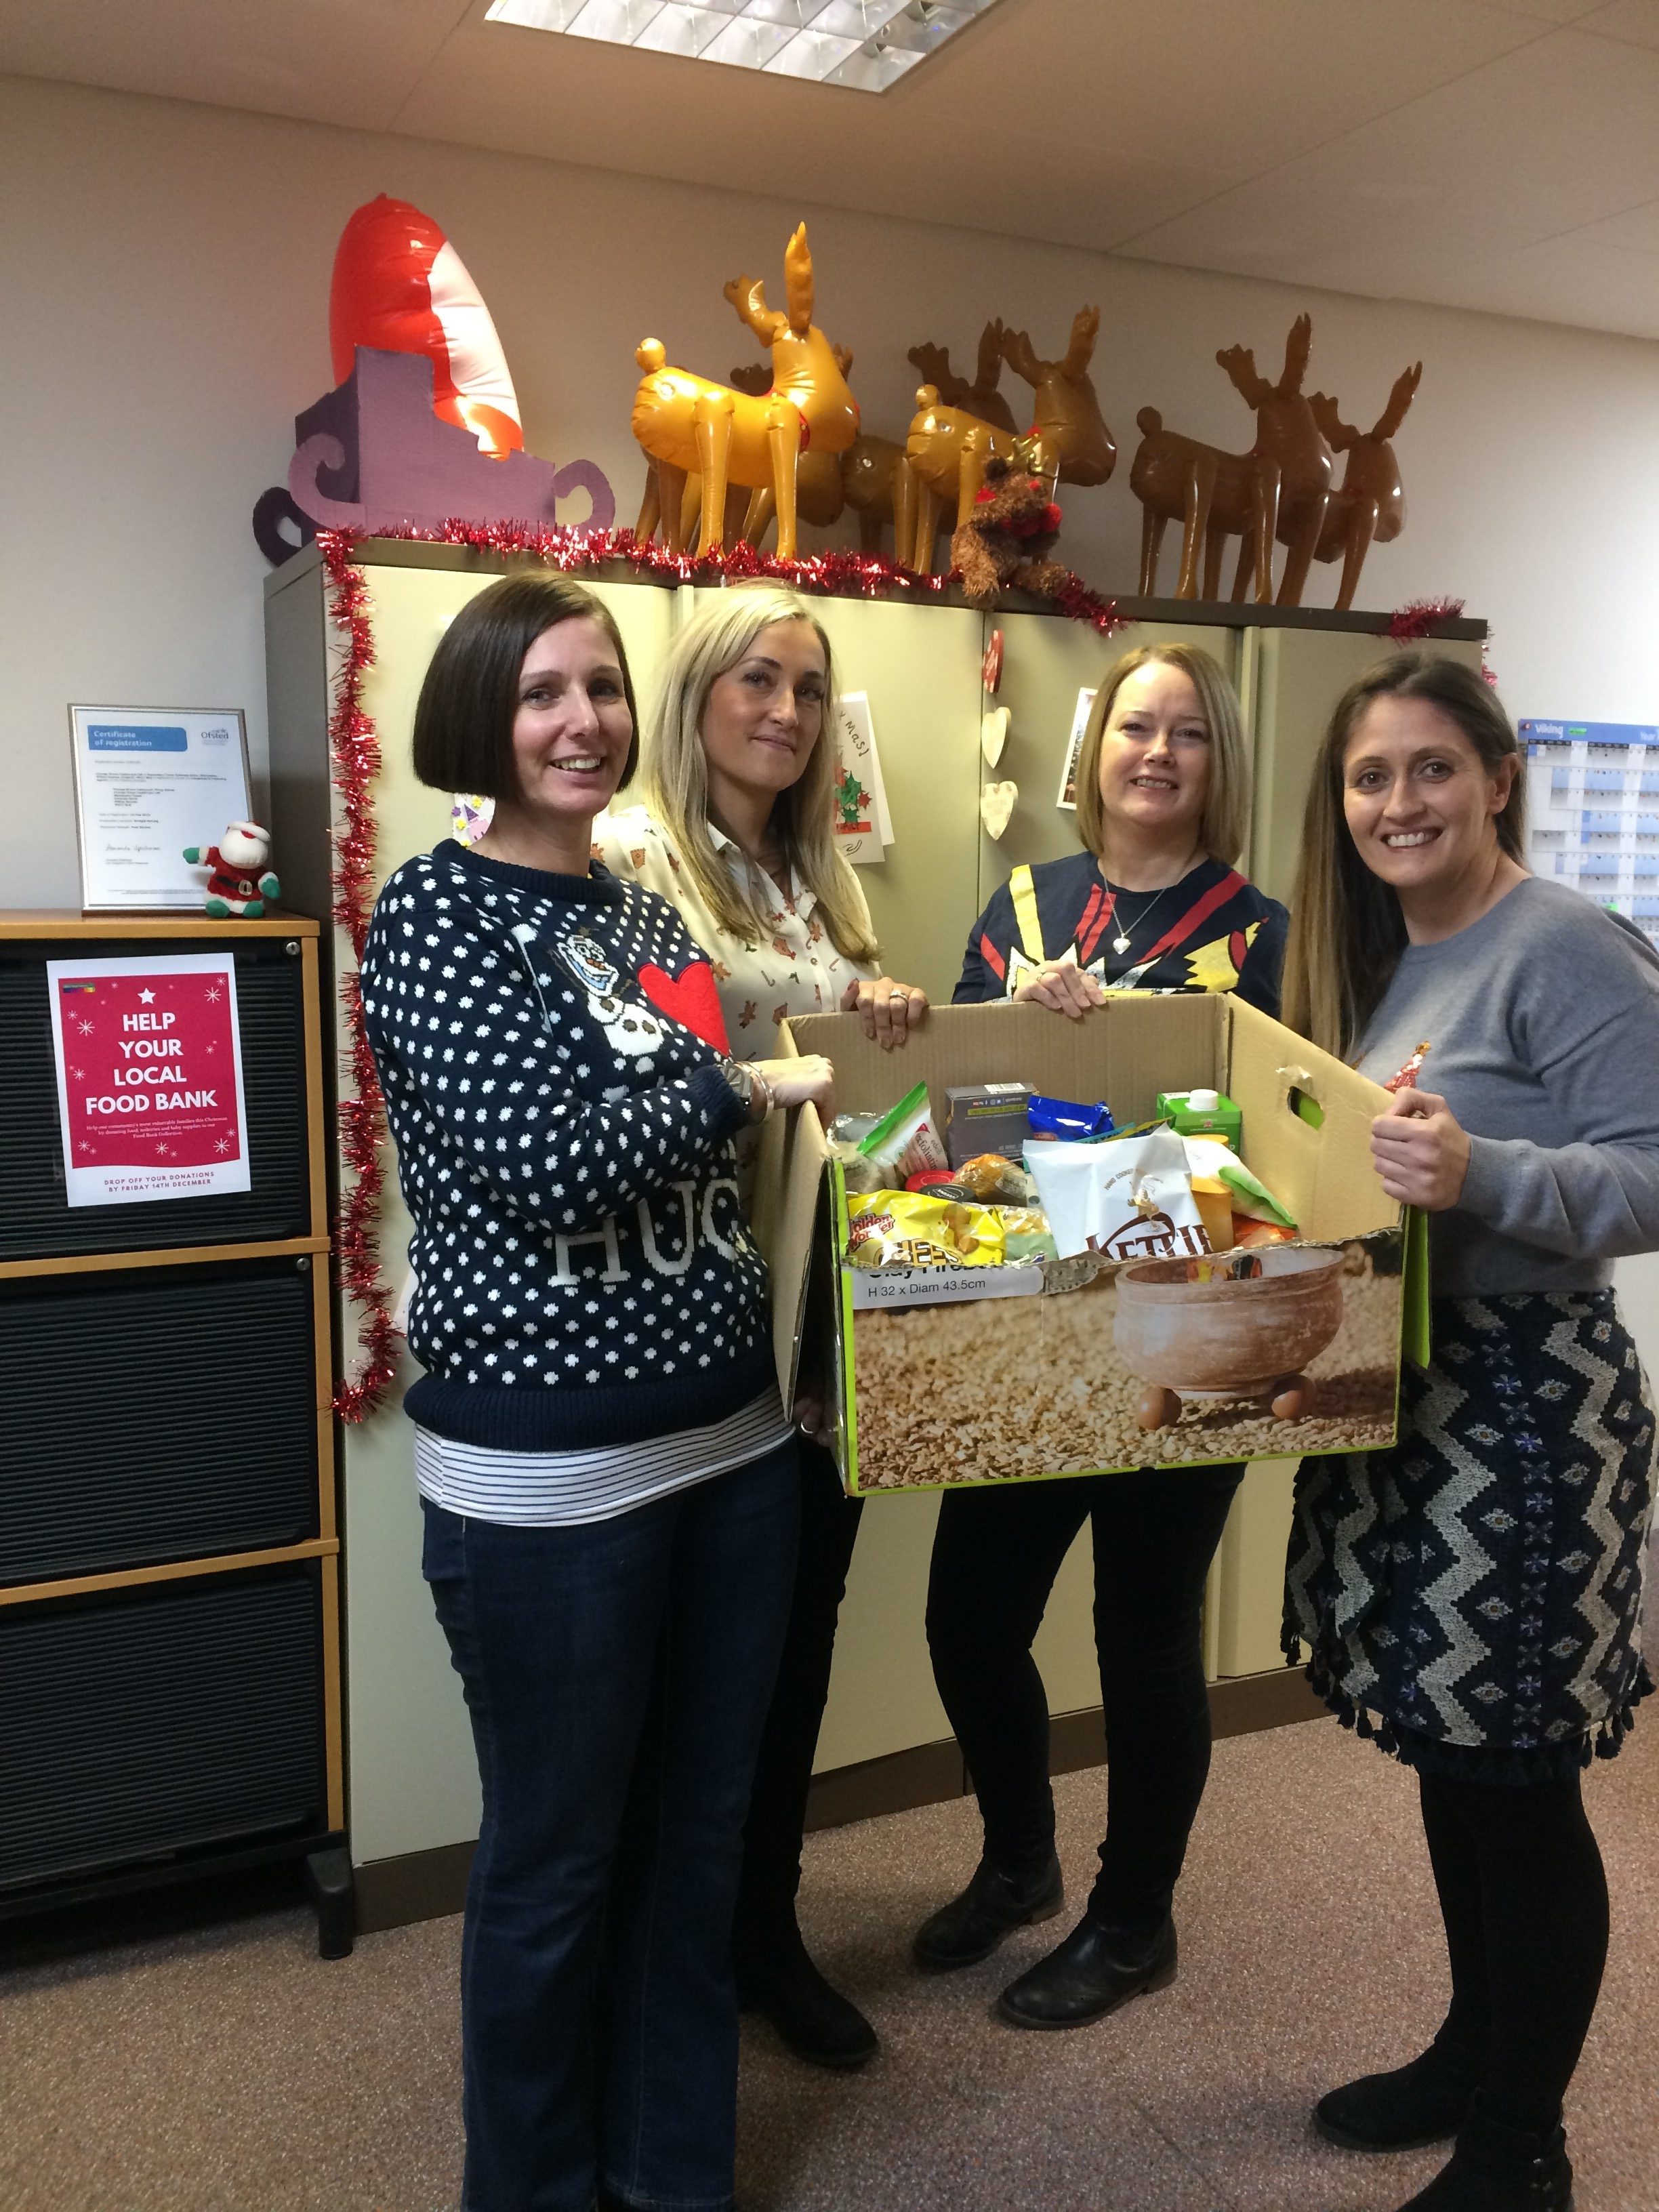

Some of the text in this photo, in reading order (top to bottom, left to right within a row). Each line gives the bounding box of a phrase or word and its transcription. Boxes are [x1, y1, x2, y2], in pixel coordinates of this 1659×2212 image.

[201, 731, 228, 739] Ofsted
[123, 1012, 176, 1031] HELP
[118, 1039, 184, 1059] YOUR
[114, 1065, 186, 1086] LOCAL
[86, 1090, 218, 1115] FOOD BANK
[169, 1171, 214, 1181] DONATIONS
[173, 1179, 211, 1187] DECEMBER
[1104, 1178, 1116, 1191] HAND
[868, 1288, 877, 1297] H
[881, 1286, 895, 1296] 32
[909, 1283, 939, 1294] Diam
[943, 1279, 985, 1291] 43.5cm
